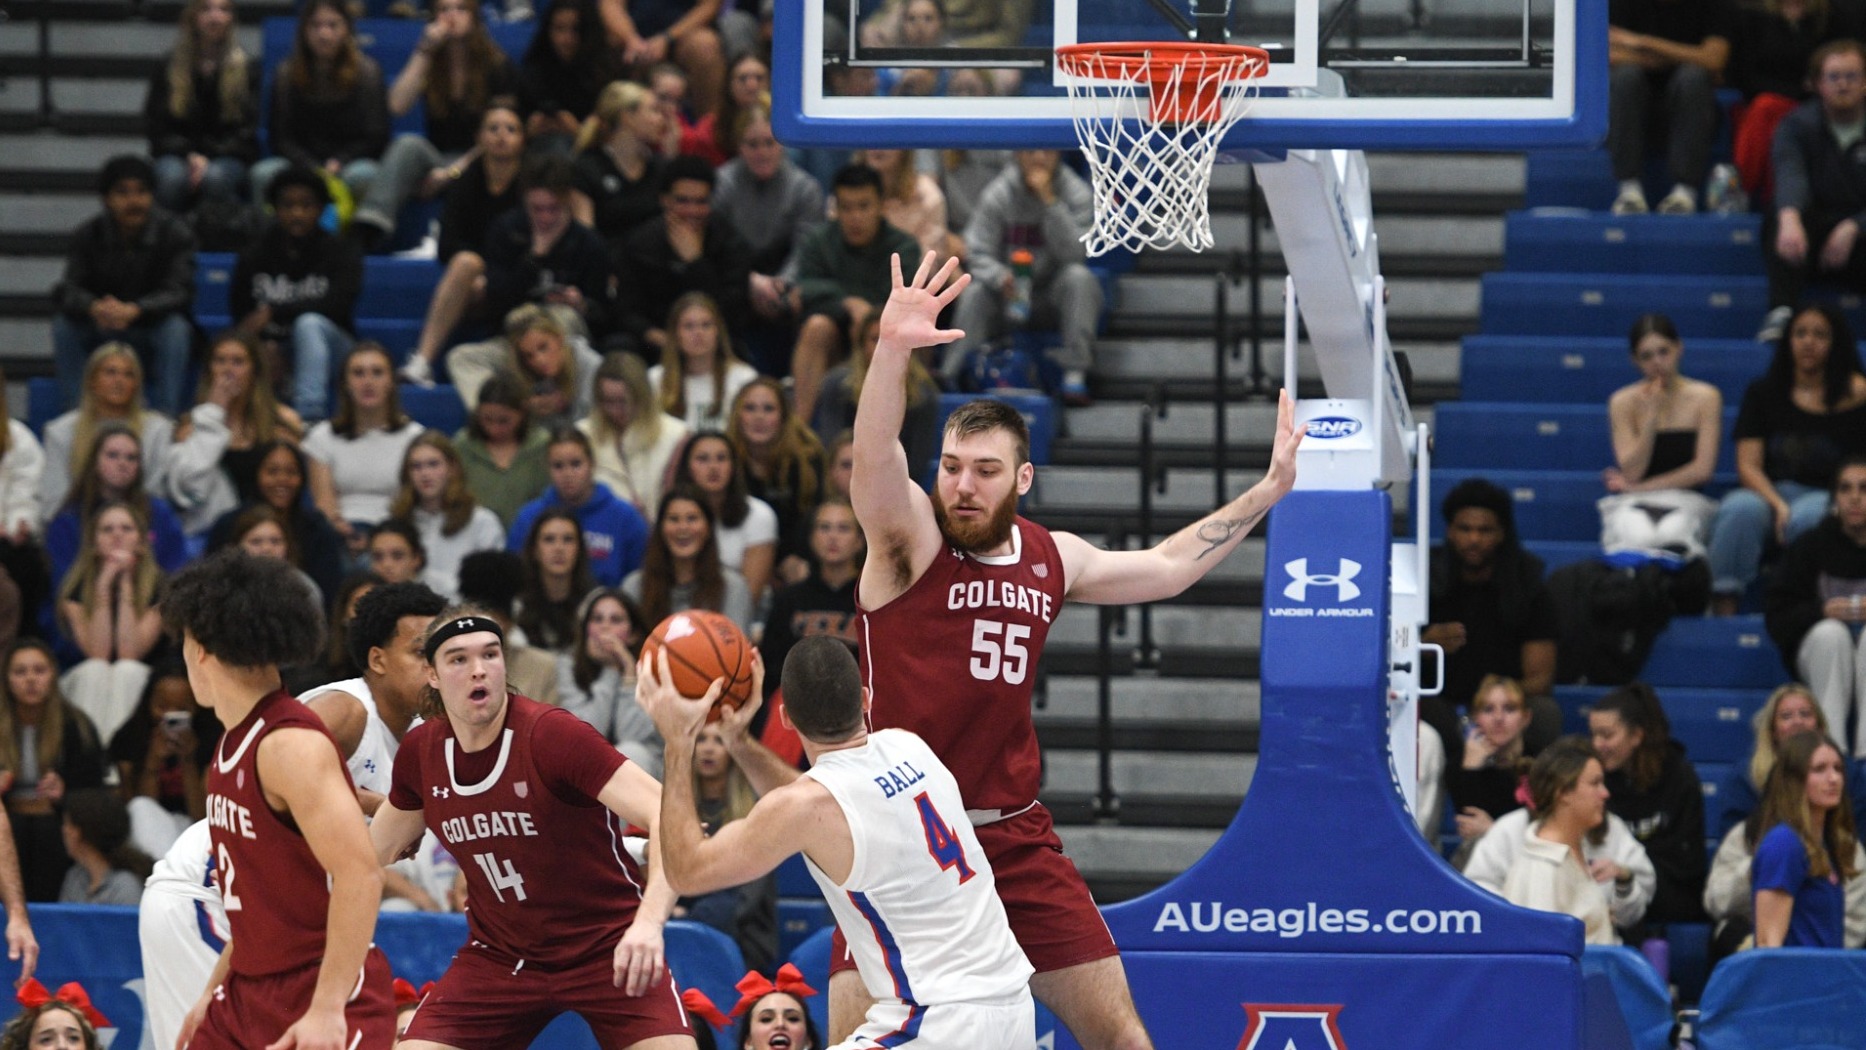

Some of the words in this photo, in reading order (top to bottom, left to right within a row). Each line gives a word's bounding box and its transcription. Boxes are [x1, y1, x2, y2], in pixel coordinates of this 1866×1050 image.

[947, 579, 1052, 624] COLGATE
[1269, 608, 1314, 617] UNDER
[1316, 608, 1374, 617] ARMOUR
[969, 618, 1031, 685] 55
[874, 761, 926, 799] BALL
[441, 811, 539, 844] COLGATE
[913, 790, 977, 886] 4
[218, 842, 242, 911] 2
[472, 852, 527, 903] 14
[1152, 902, 1482, 938] AUeagles.com
